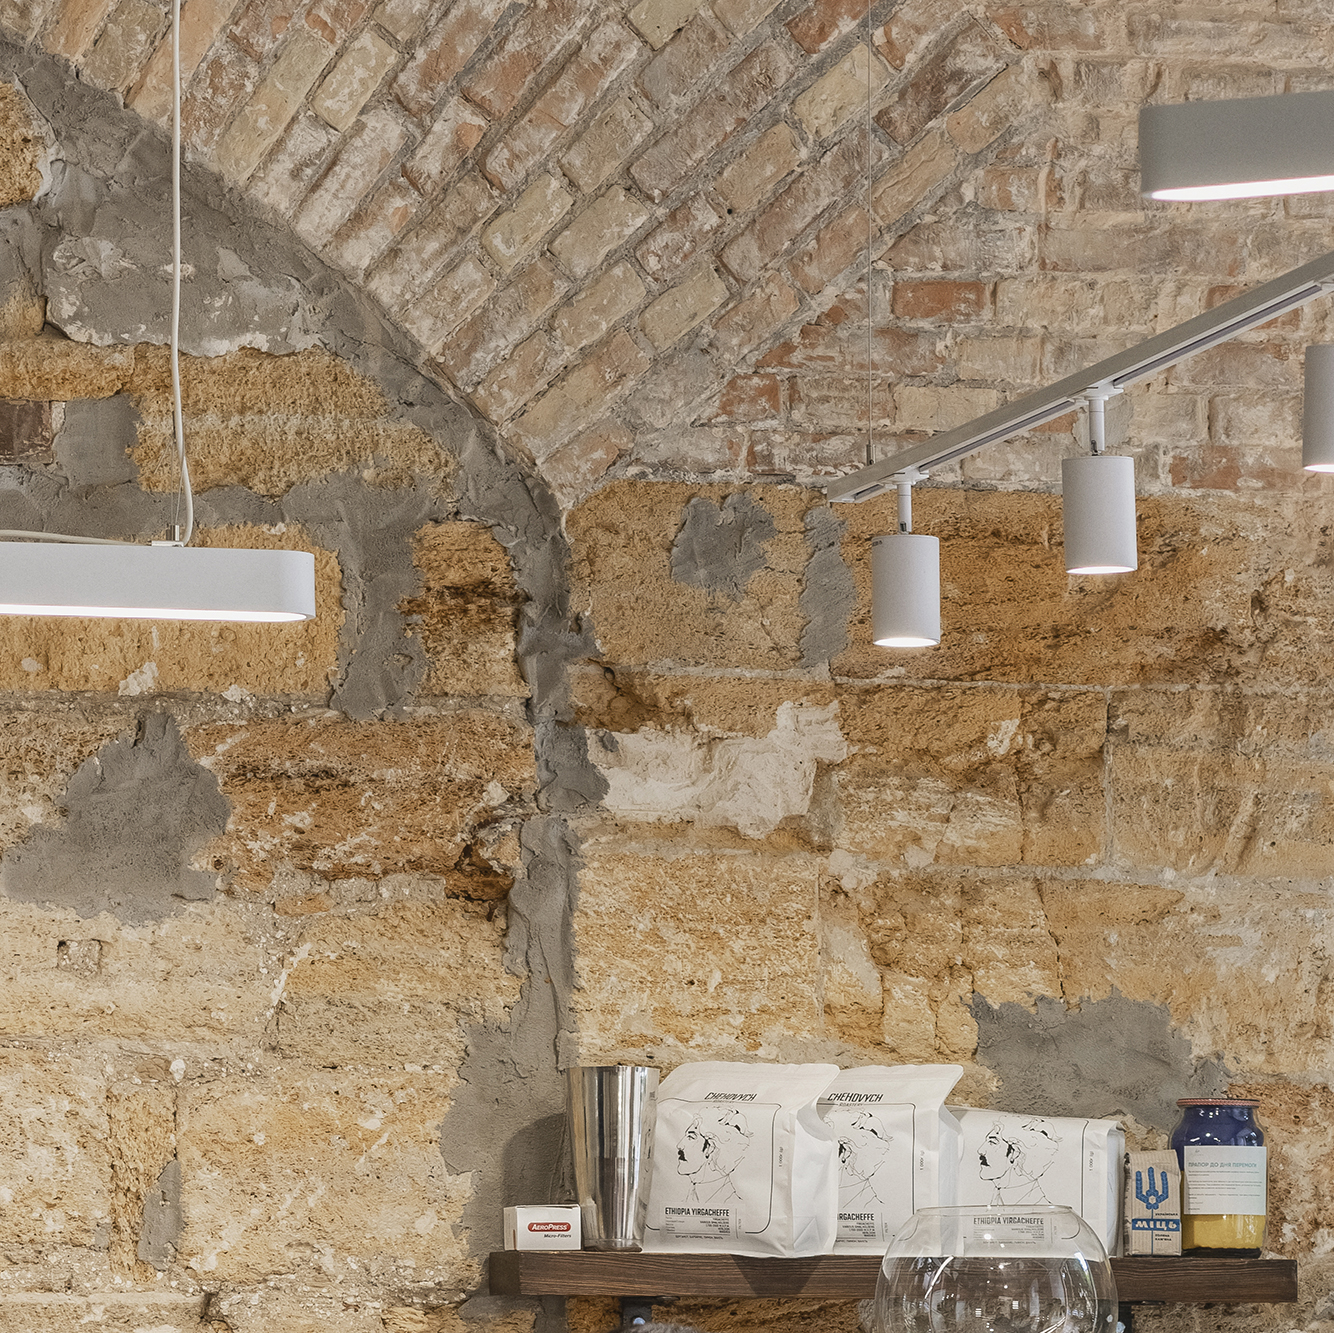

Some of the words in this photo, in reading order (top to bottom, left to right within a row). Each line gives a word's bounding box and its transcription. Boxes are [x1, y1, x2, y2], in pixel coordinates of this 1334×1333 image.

[827, 1092, 883, 1102] CHEHOVYCH
[665, 1207, 691, 1216] ETHIOPIA
[691, 1207, 730, 1217] YIRGACHEFFE
[838, 1213, 875, 1221] RGACHEFFE
[973, 1217, 1002, 1225] ETHIOPIA
[1002, 1217, 1044, 1225] YIRGACHEFFE
[1135, 1220, 1177, 1230] МІЦЬ
